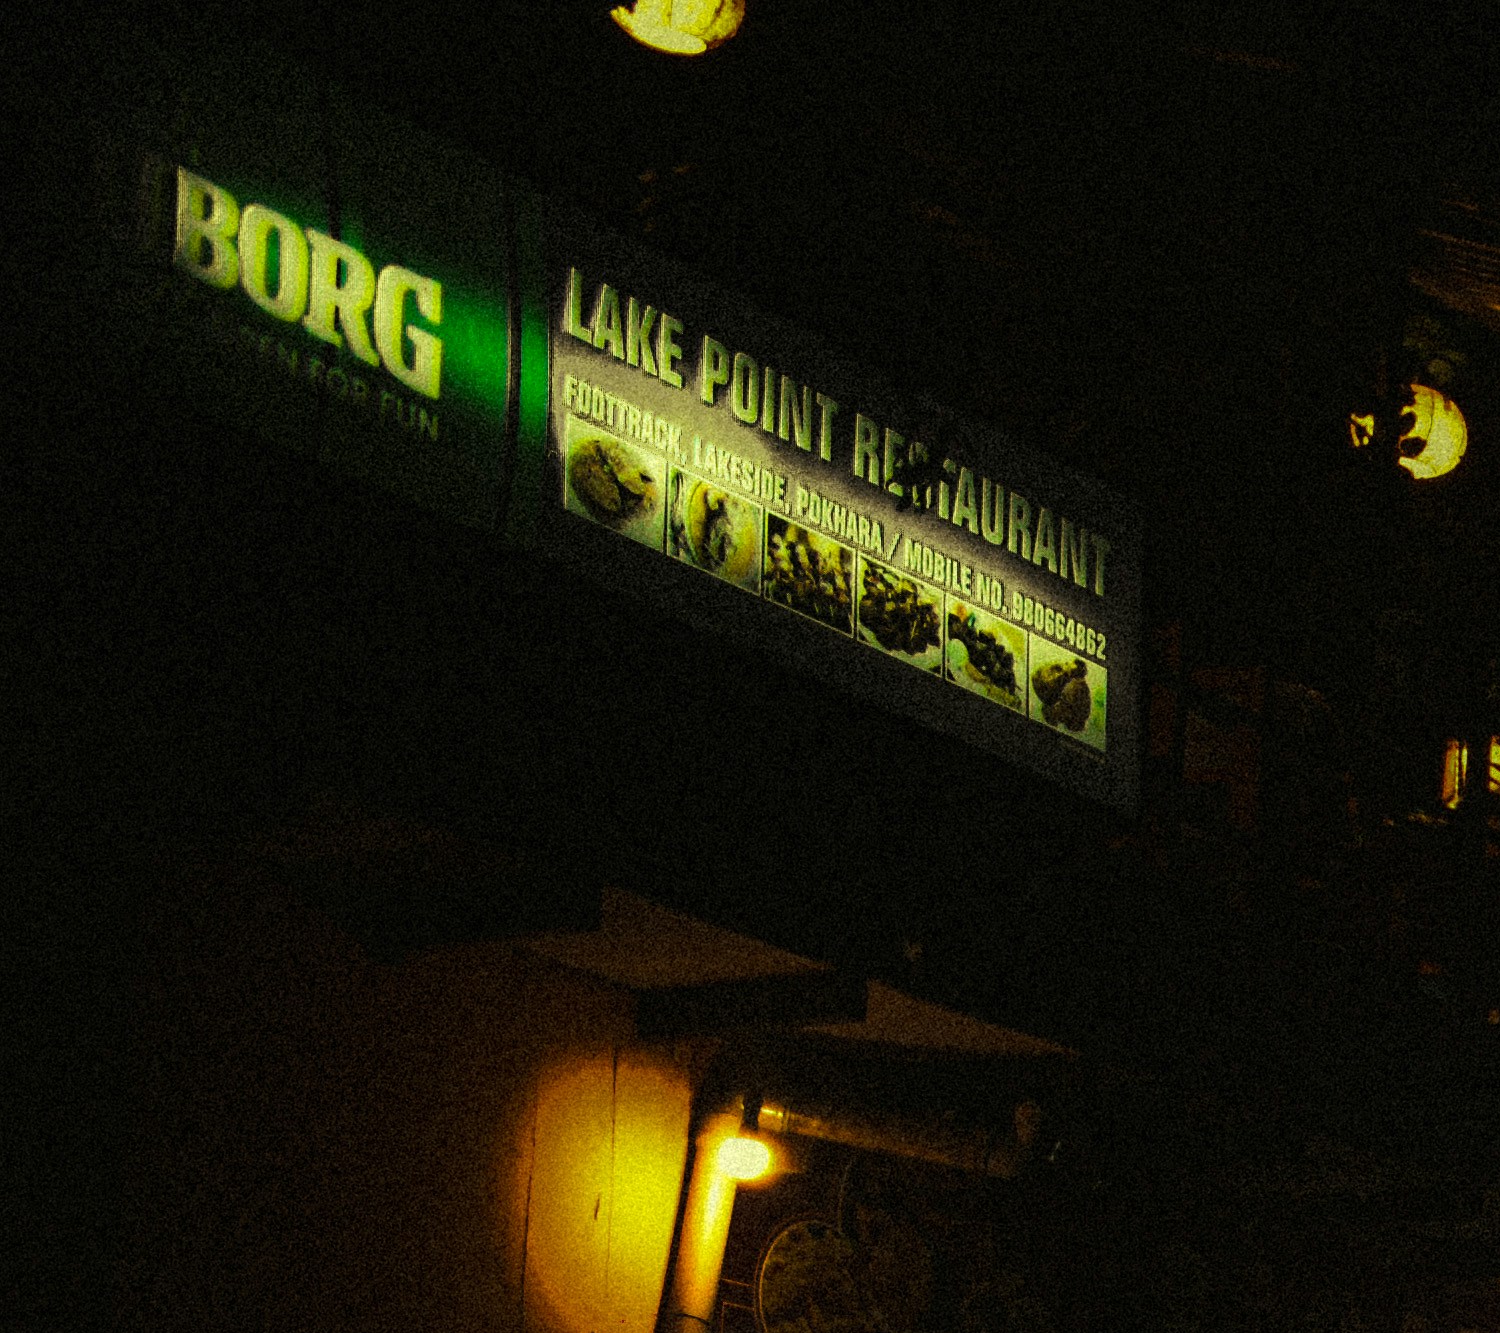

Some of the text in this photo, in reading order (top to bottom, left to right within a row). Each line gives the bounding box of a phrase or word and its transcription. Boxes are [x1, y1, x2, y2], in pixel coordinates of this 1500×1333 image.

[565, 266, 684, 389] LAKE
[700, 334, 839, 462] POINT
[693, 434, 790, 514] LAKESIDE,
[795, 486, 885, 555] POKHARA
[903, 540, 973, 596] MOBILE
[977, 570, 1009, 615] NO.
[1012, 591, 1107, 662] 980664862
